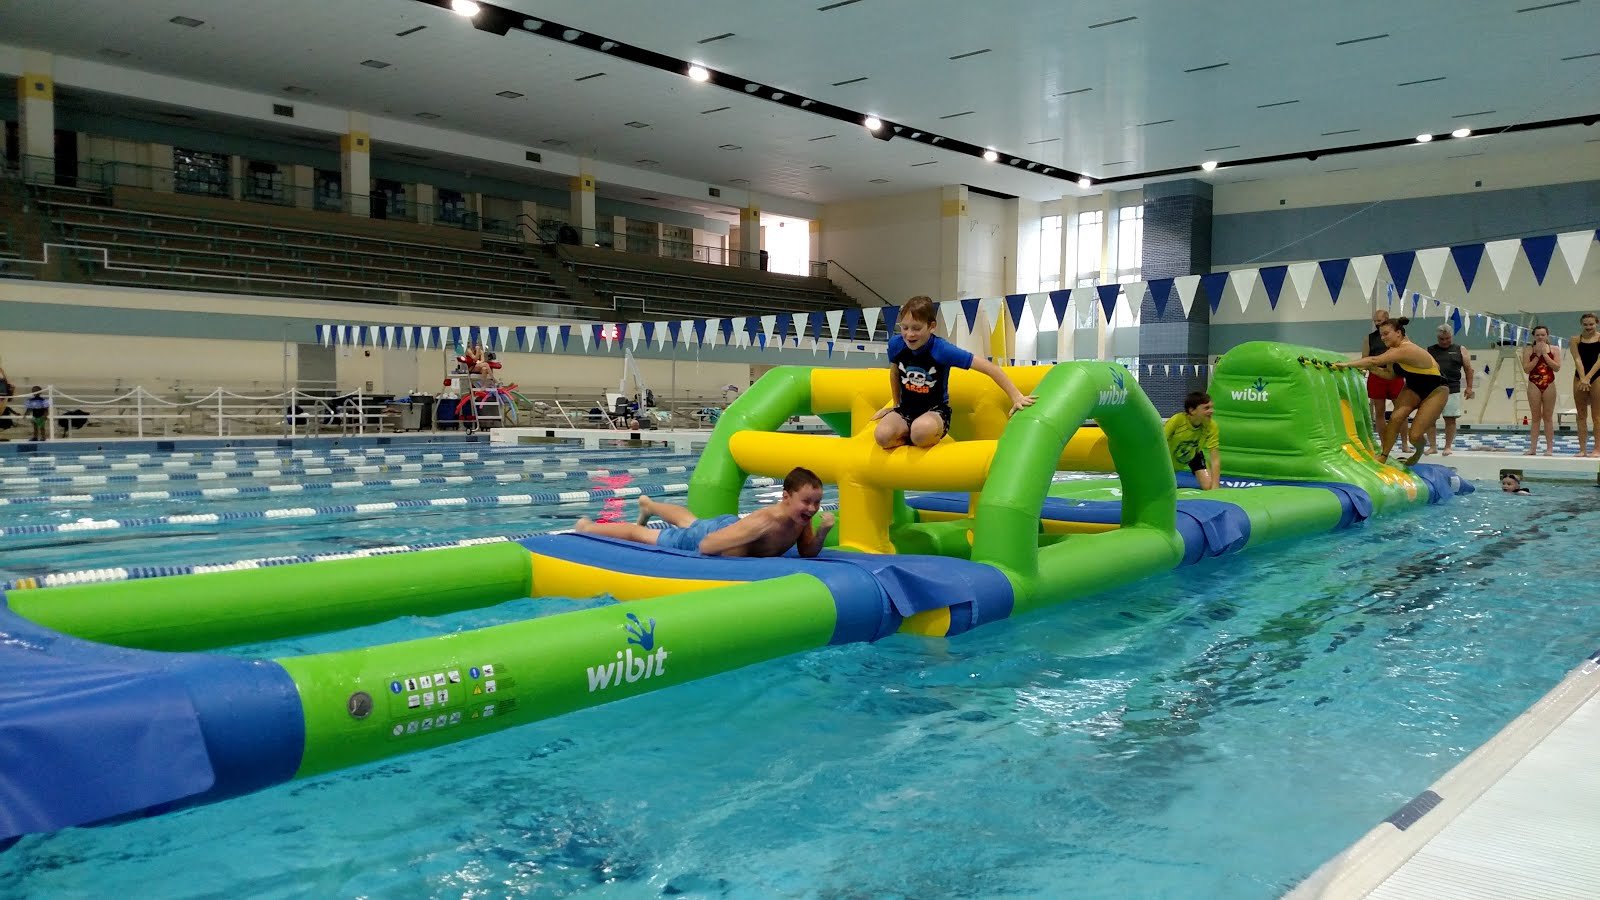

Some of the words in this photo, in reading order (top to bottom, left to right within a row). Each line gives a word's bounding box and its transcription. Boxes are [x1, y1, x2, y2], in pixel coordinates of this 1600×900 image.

[1098, 385, 1128, 406] wibit
[1231, 388, 1269, 402] wibit
[586, 646, 668, 693] wibit
